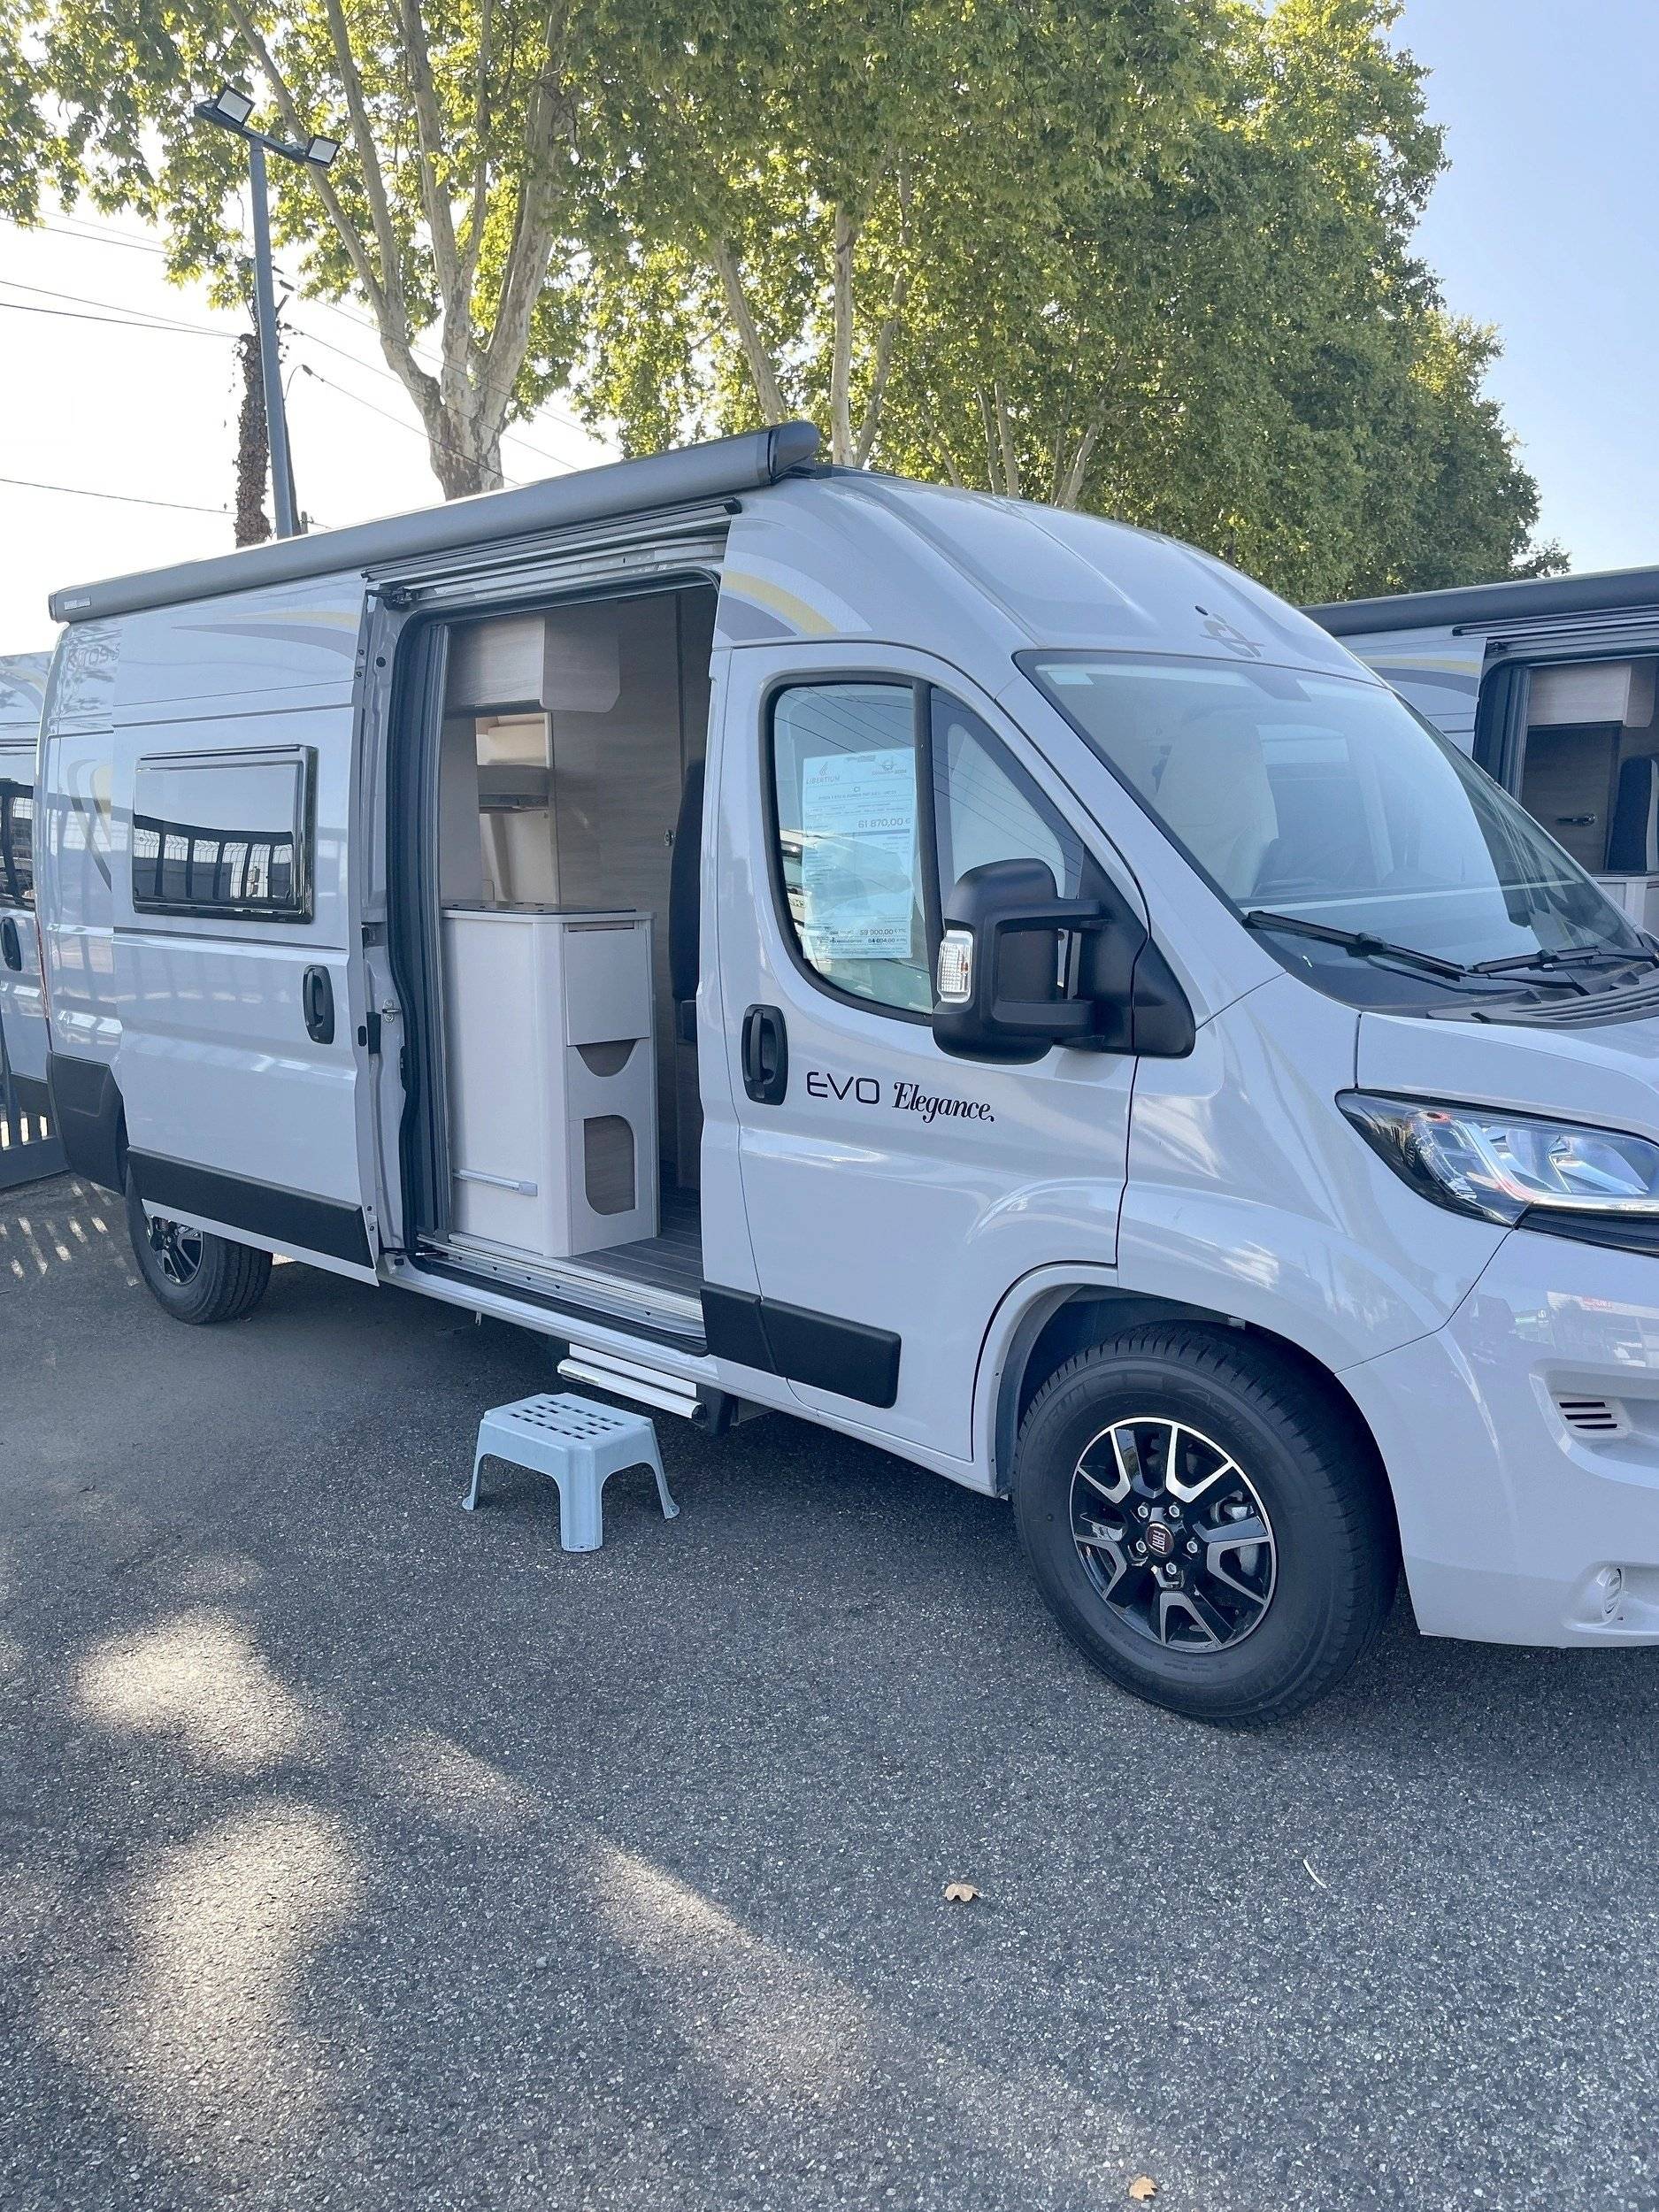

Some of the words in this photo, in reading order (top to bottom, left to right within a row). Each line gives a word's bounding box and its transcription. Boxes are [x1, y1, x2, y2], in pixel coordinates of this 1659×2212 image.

[870, 818, 903, 828] 870,00
[807, 1071, 880, 1105] EVO
[1152, 1530, 1166, 1552] FIAT
